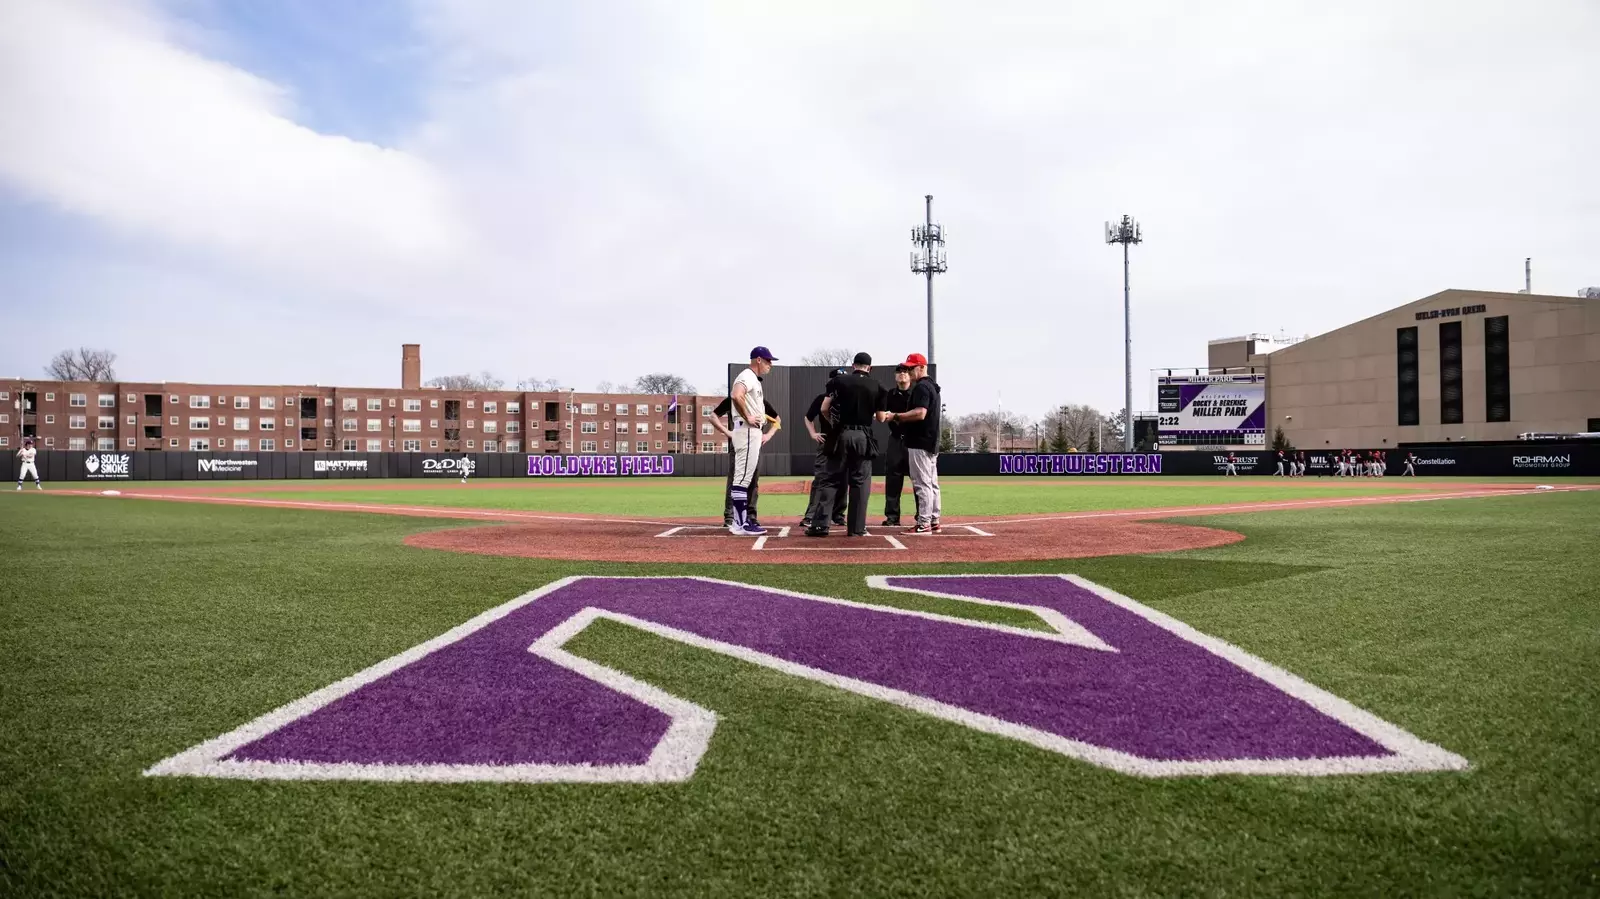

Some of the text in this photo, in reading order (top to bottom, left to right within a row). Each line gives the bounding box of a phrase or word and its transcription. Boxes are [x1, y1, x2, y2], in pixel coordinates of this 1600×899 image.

[1462, 304, 1486, 315] ARENA
[1216, 375, 1234, 383] PARK
[1193, 407, 1247, 416] MILLER PARK
[1159, 417, 1179, 425] 2:22
[101, 454, 130, 464] SOUL &
[422, 459, 475, 469] D&D DS
[1000, 454, 1162, 473] NORTHWESTERN
[1213, 455, 1258, 463] WINRUST
[1513, 454, 1570, 465] ROHRMAN
[101, 464, 129, 473] SMOKE
[527, 455, 674, 475] KOLDYKE FIELD
[143, 573, 1471, 783] N
